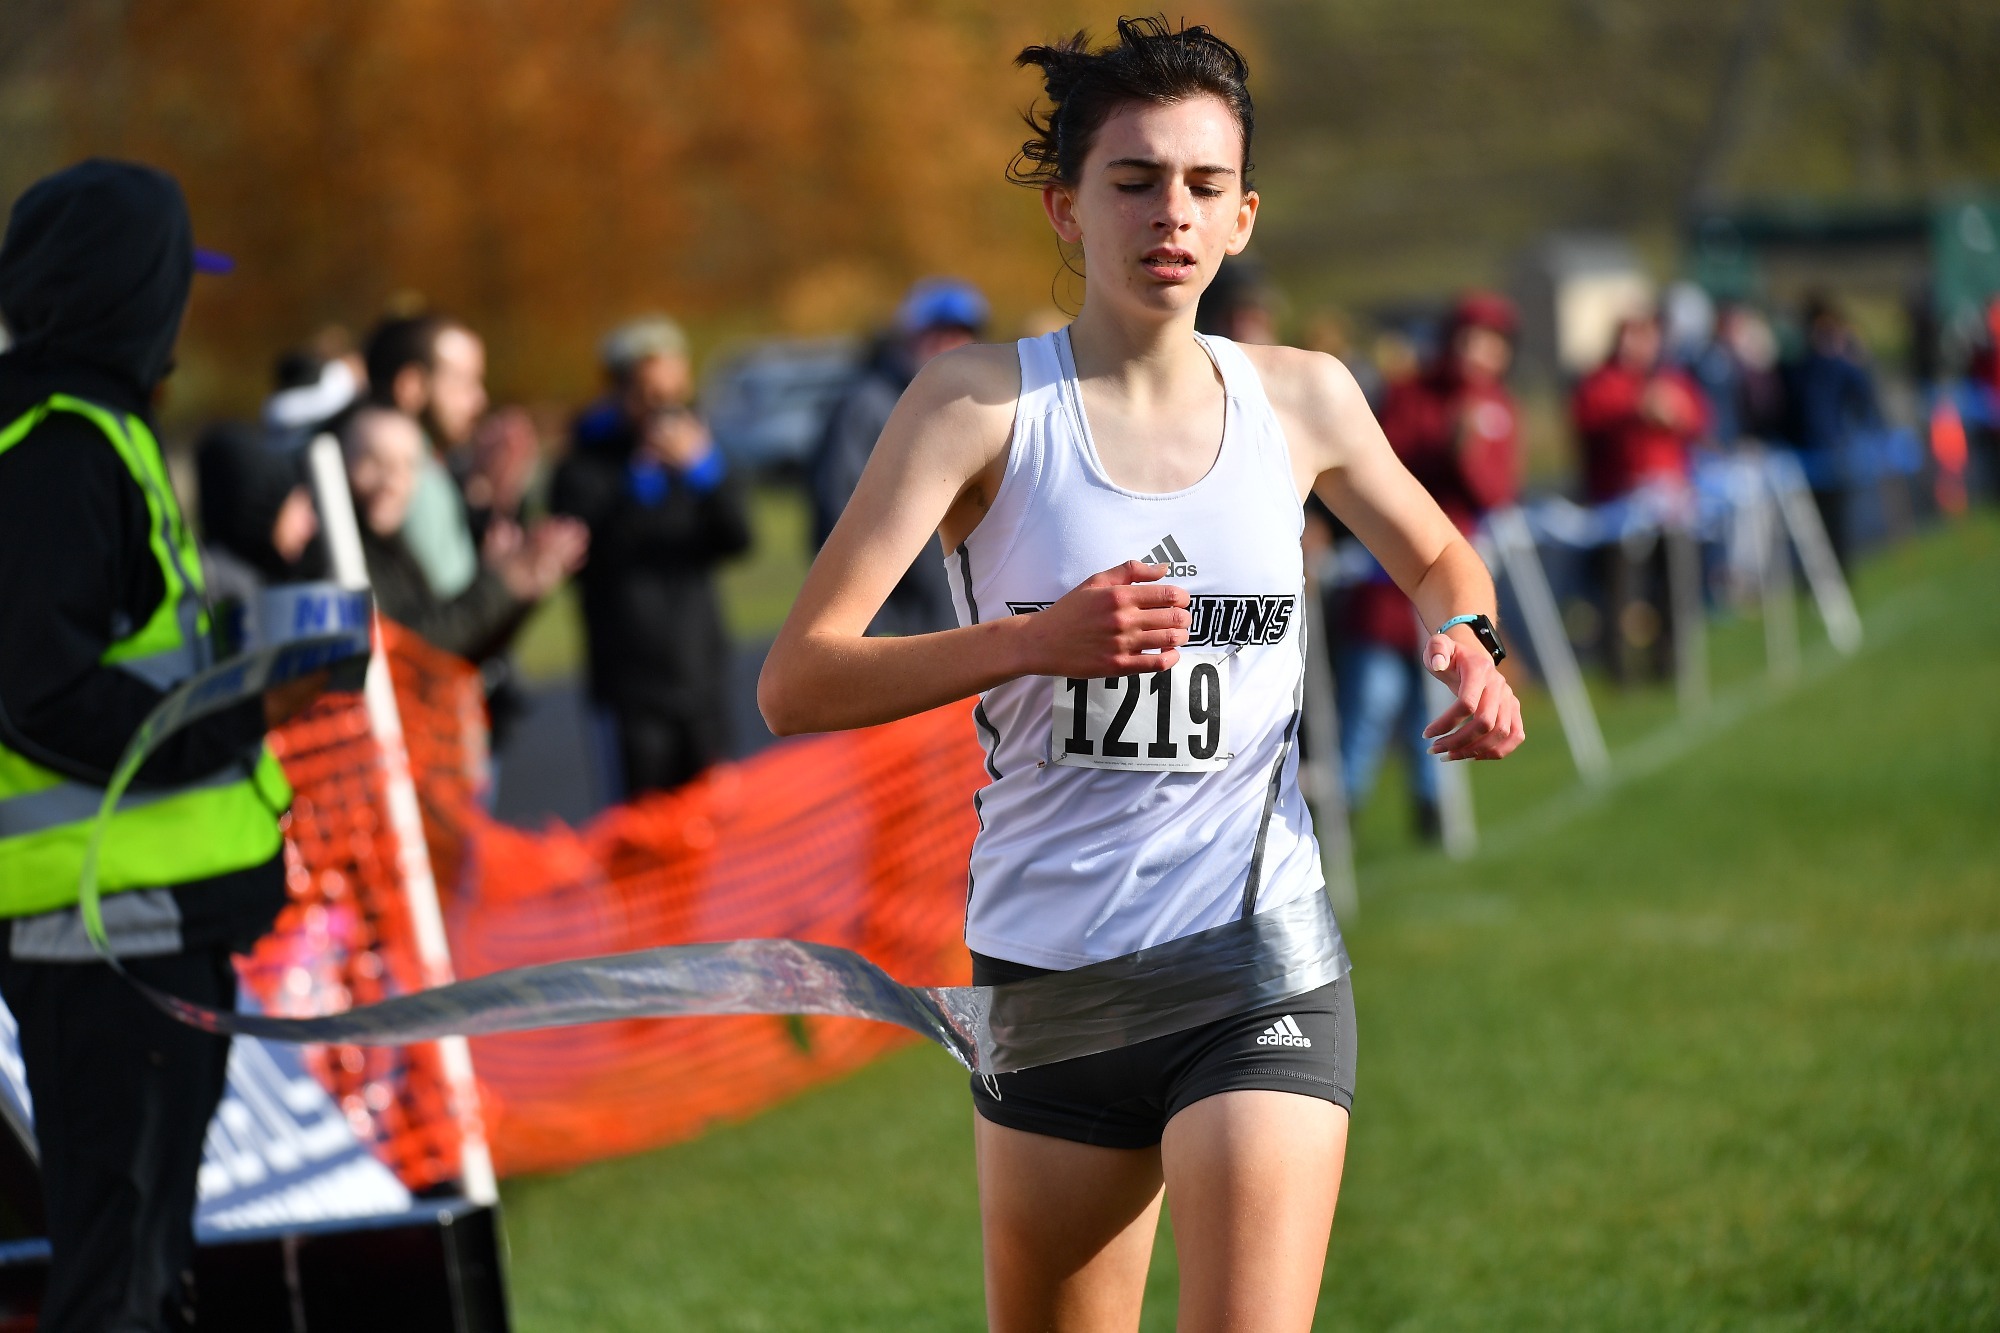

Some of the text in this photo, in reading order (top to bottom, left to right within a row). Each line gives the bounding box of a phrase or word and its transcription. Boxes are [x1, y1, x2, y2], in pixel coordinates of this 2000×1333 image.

[1152, 562, 1197, 577] das
[1006, 594, 1296, 647] UINS
[1064, 663, 1220, 760] 1219
[1256, 1034, 1312, 1048] adidas
